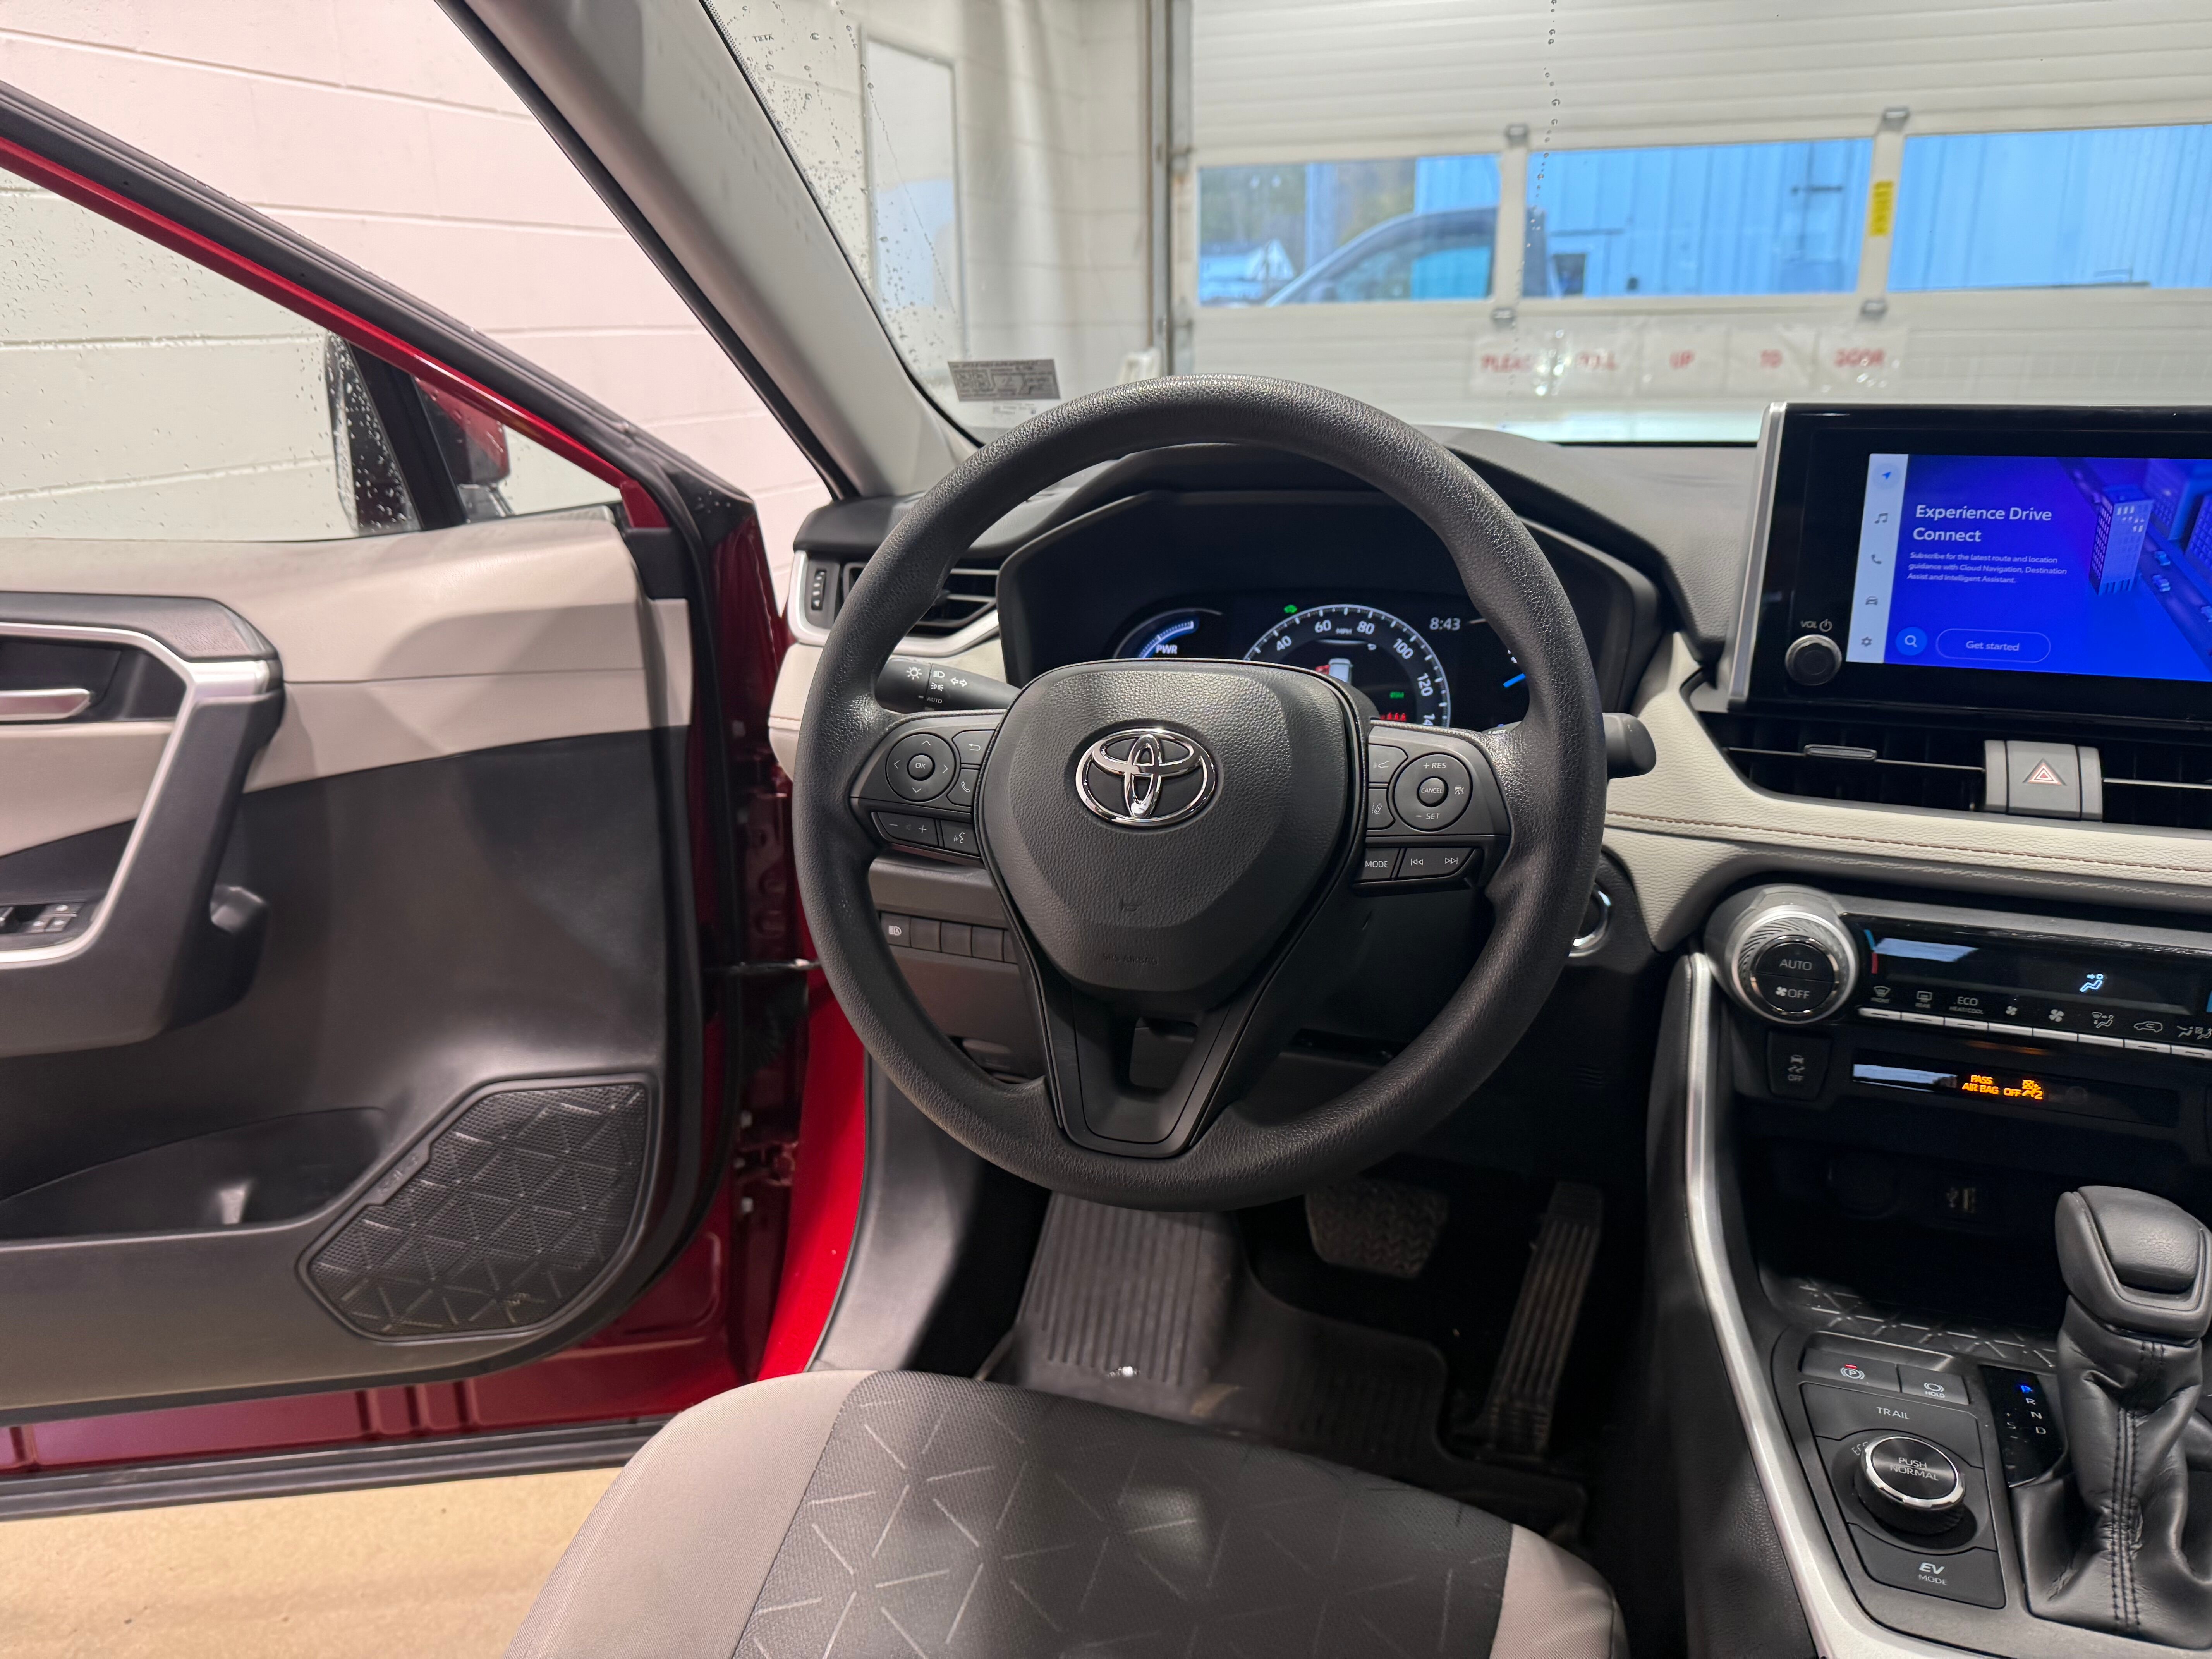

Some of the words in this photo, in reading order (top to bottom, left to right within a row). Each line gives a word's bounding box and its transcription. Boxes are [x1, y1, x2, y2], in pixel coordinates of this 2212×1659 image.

[1916, 505, 2006, 521] Experience
[2009, 507, 2052, 521] Drive
[1913, 527, 1982, 542] Connect
[1944, 574, 1981, 582] Intelligent
[1314, 619, 1332, 633] 60
[1357, 621, 1375, 635] 80
[1429, 617, 1460, 631] 8:43
[1156, 644, 1178, 654] PWR
[1276, 635, 1292, 651] 40
[1393, 638, 1413, 659] 100
[1966, 641, 1984, 649] Get
[1986, 642, 2020, 651] started
[1417, 673, 1433, 697] 120
[1779, 959, 1812, 970] AUTO
[1788, 989, 1810, 999] OFF
[1957, 996, 1978, 1006] ECO
[1971, 1075, 1994, 1085] PASS
[1962, 1083, 1978, 1091] AIR
[1980, 1085, 1999, 1095] BAG
[2004, 1088, 2022, 1097] OFF
[1876, 1407, 1910, 1420] TRAIL
[2031, 1411, 2043, 1419] N
[2035, 1426, 2047, 1435] D
[1898, 1457, 1927, 1468] PUSH
[1890, 1463, 1939, 1481] NORMAL
[1919, 1562, 1945, 1575] EV
[1918, 1574, 1948, 1585] MODE
